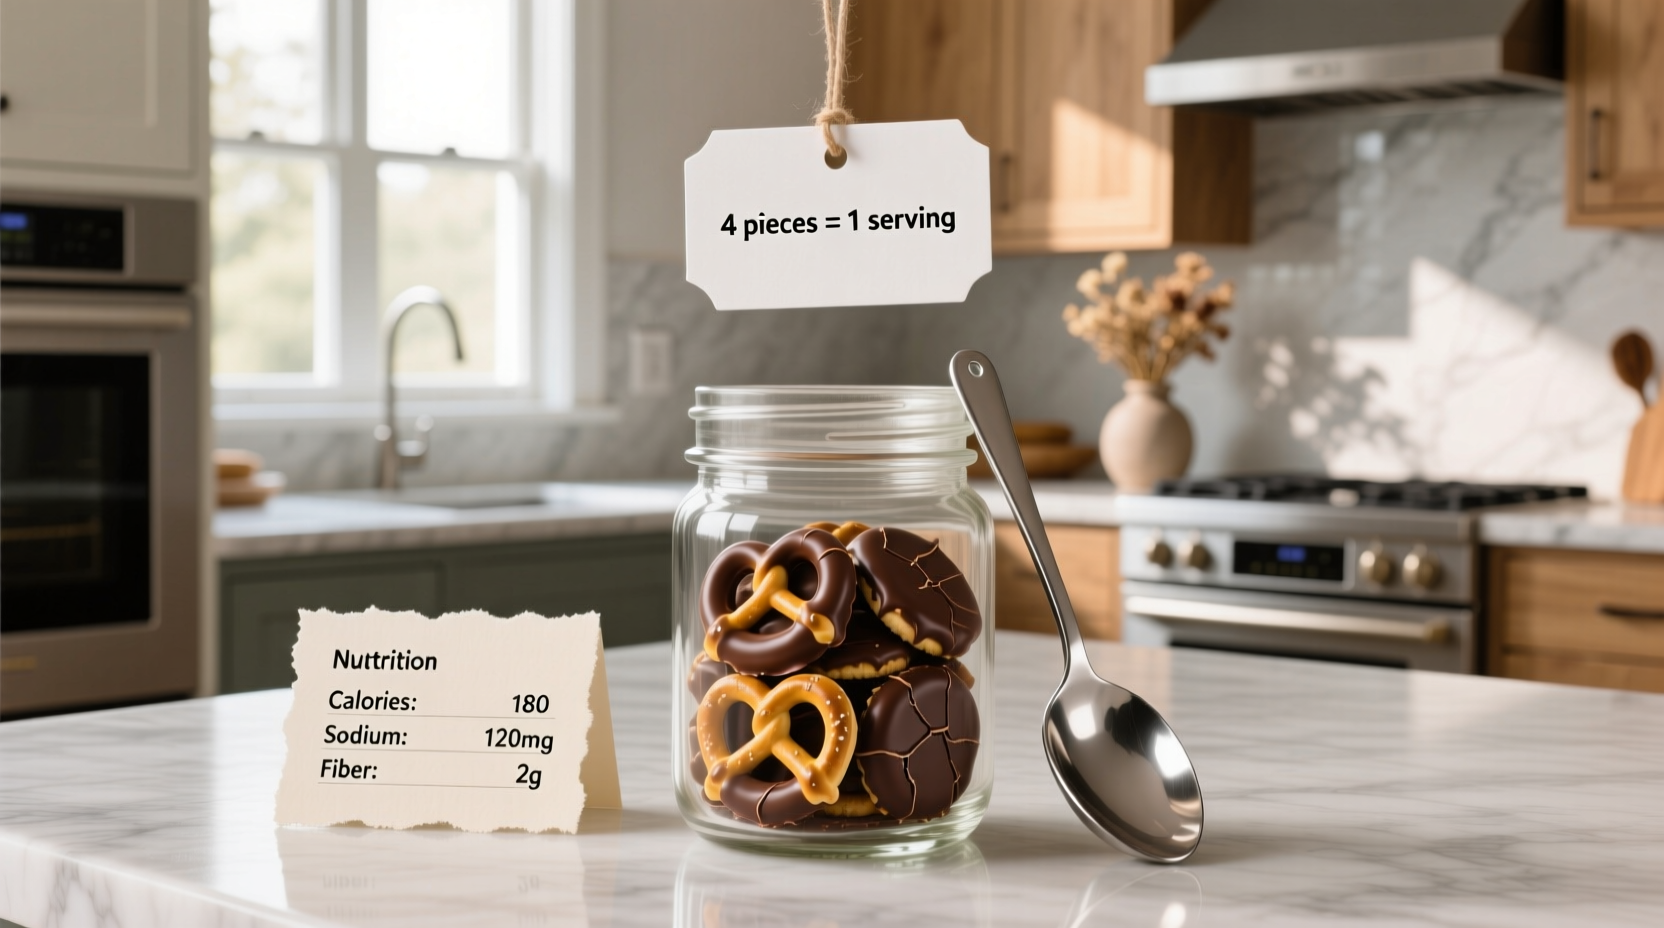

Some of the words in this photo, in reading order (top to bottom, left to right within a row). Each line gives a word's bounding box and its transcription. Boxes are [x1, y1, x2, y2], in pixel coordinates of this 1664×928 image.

[720, 213, 738, 236] 4
[743, 211, 818, 242] pieces
[825, 216, 841, 229] =
[847, 209, 859, 232] 1
[868, 205, 956, 234] serving
[328, 689, 417, 711] Calories:
[512, 694, 550, 714] 180
[323, 724, 408, 746] Sodium:
[485, 727, 554, 755] 120mg
[320, 758, 378, 780] Fiber:
[515, 763, 542, 791] 2g
